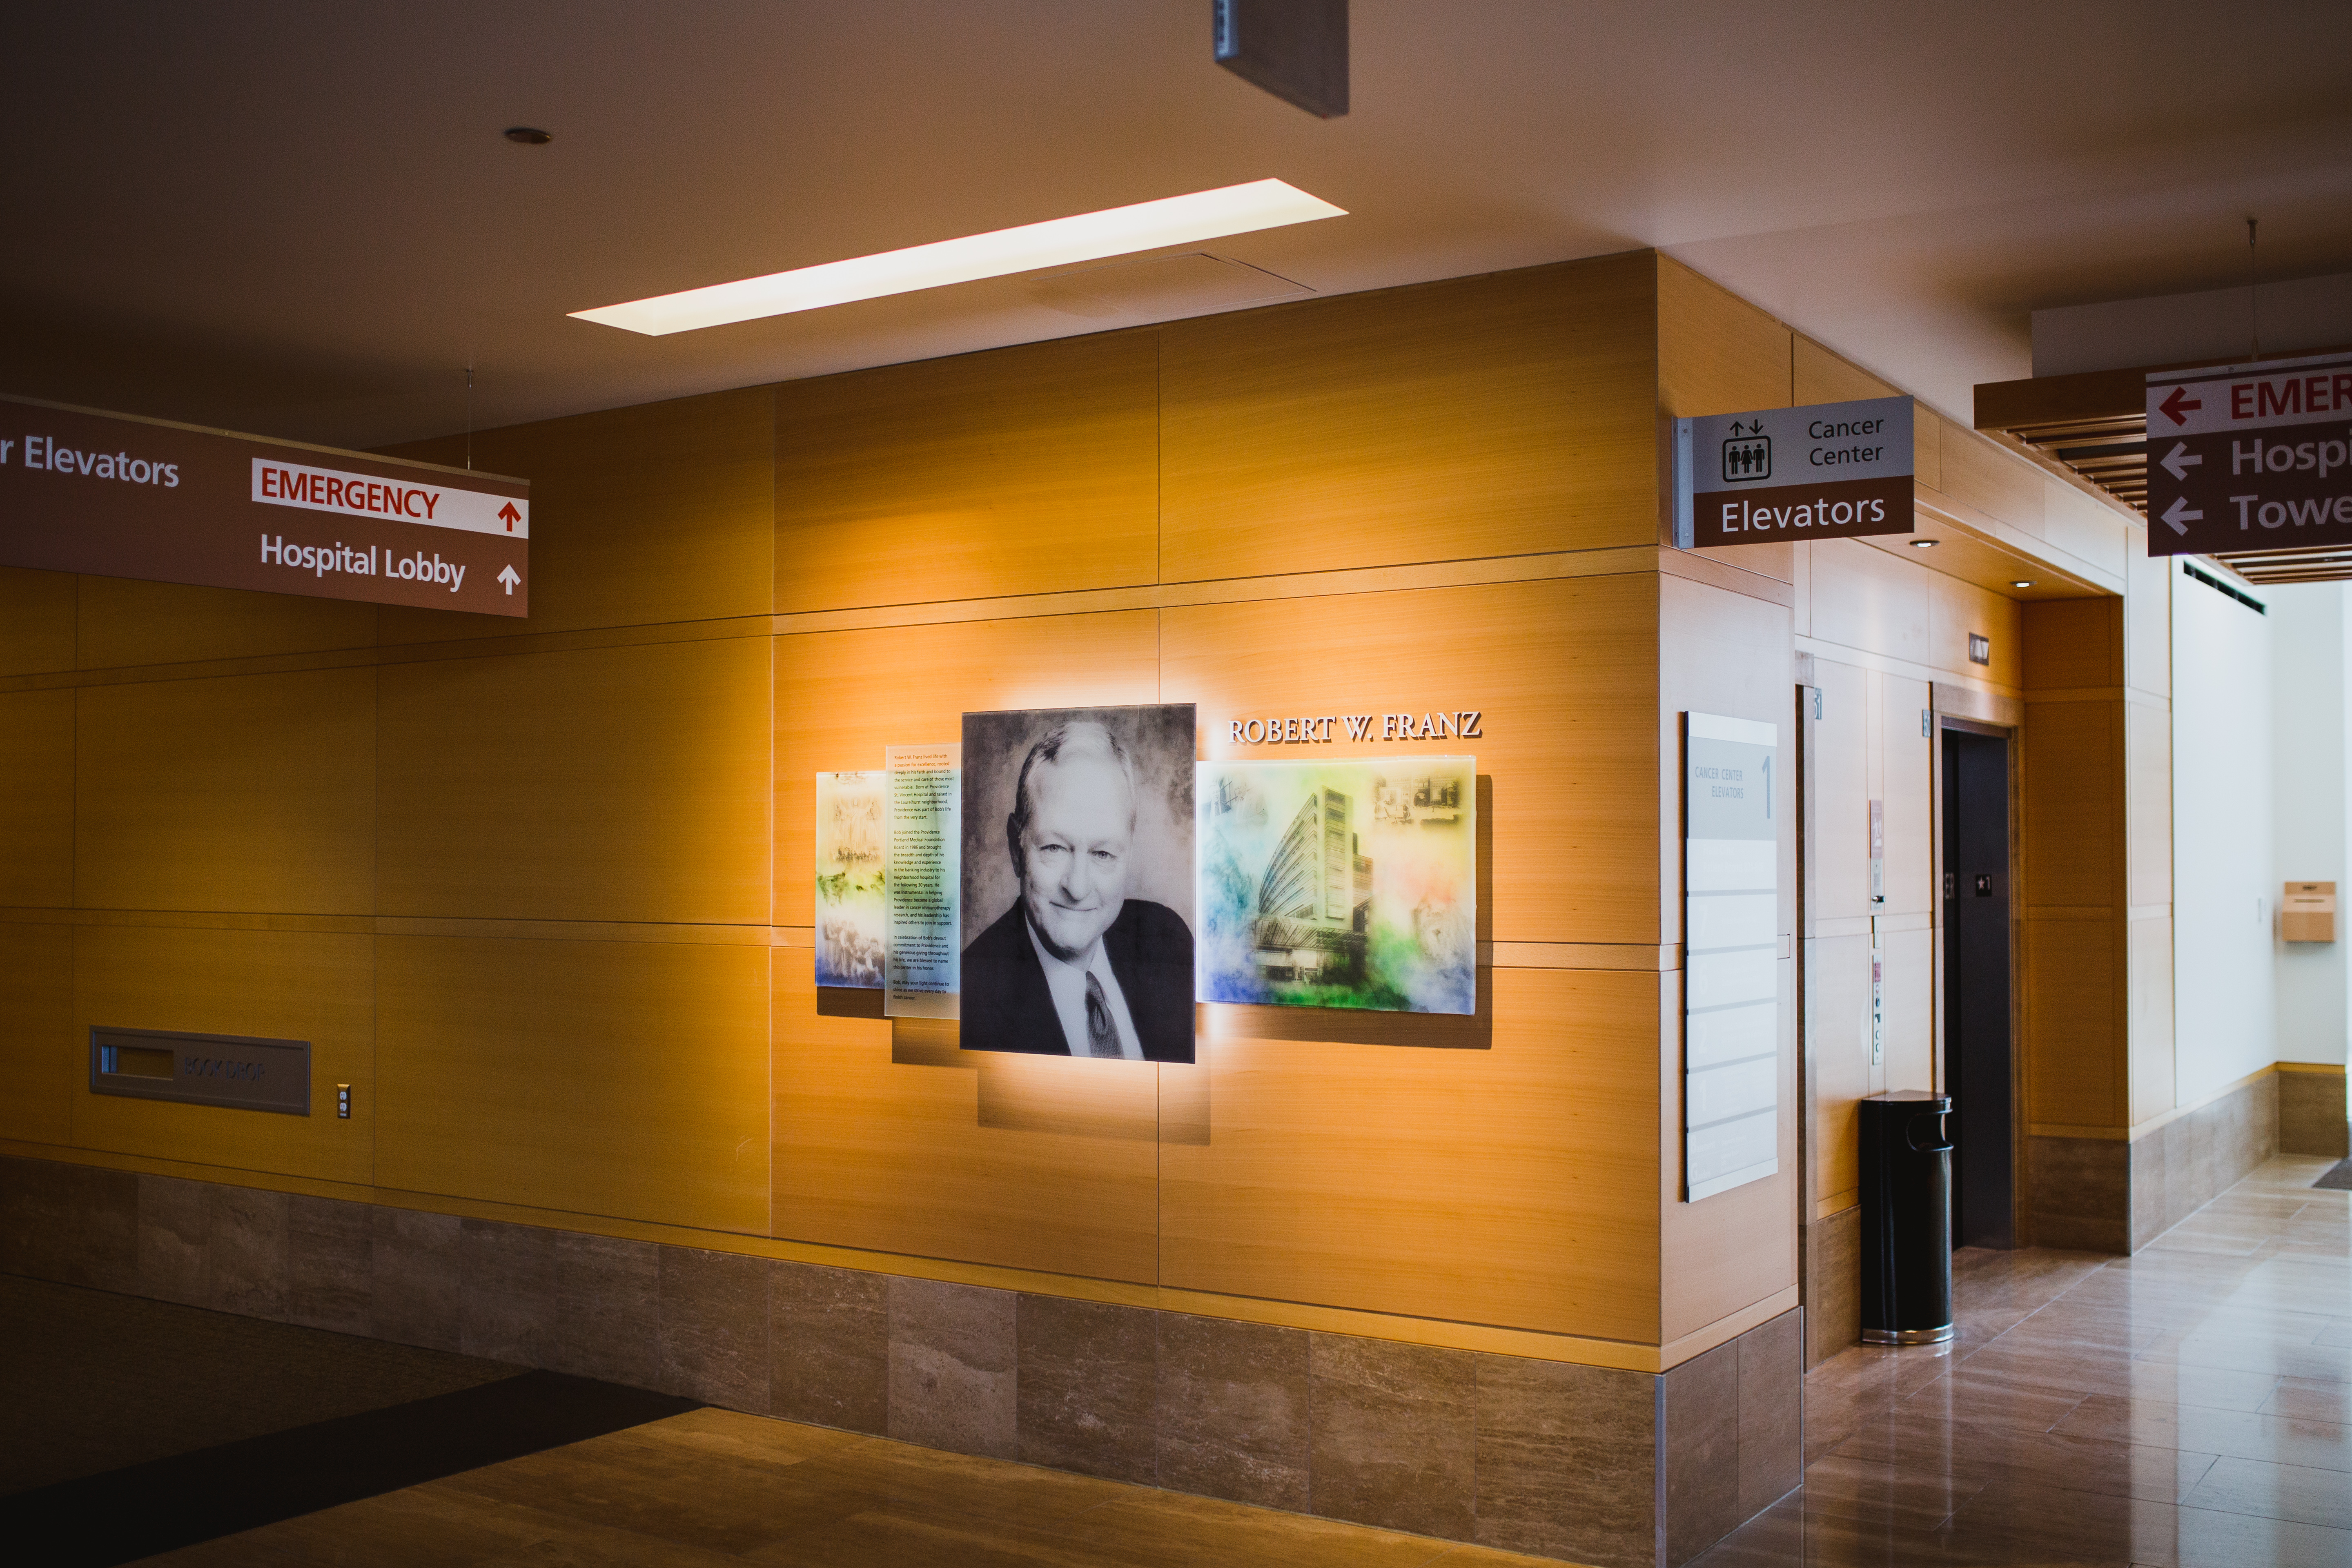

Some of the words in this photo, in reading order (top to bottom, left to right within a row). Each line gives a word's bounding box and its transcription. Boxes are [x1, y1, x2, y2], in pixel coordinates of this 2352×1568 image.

[2232, 374, 2352, 419] EMER
[1809, 419, 1884, 439] Cancer
[25, 435, 179, 487] Elevators
[1810, 446, 1884, 466] Center
[262, 467, 440, 519] EMERGENCY
[1723, 498, 1884, 532] Elevators
[2230, 494, 2352, 530] Towe
[261, 534, 376, 577] Hospital
[385, 549, 466, 592] Lobby
[1228, 716, 1336, 743] ROBERT
[1341, 715, 1372, 740] W.
[1382, 711, 1481, 738] FRANZ
[1695, 766, 1719, 779] CANCER
[1722, 769, 1743, 781] CENTER
[1762, 756, 1770, 819] 1
[1712, 786, 1744, 799] ELEVATORS
[185, 1058, 223, 1079] BOOK
[226, 1061, 265, 1081] DROP
